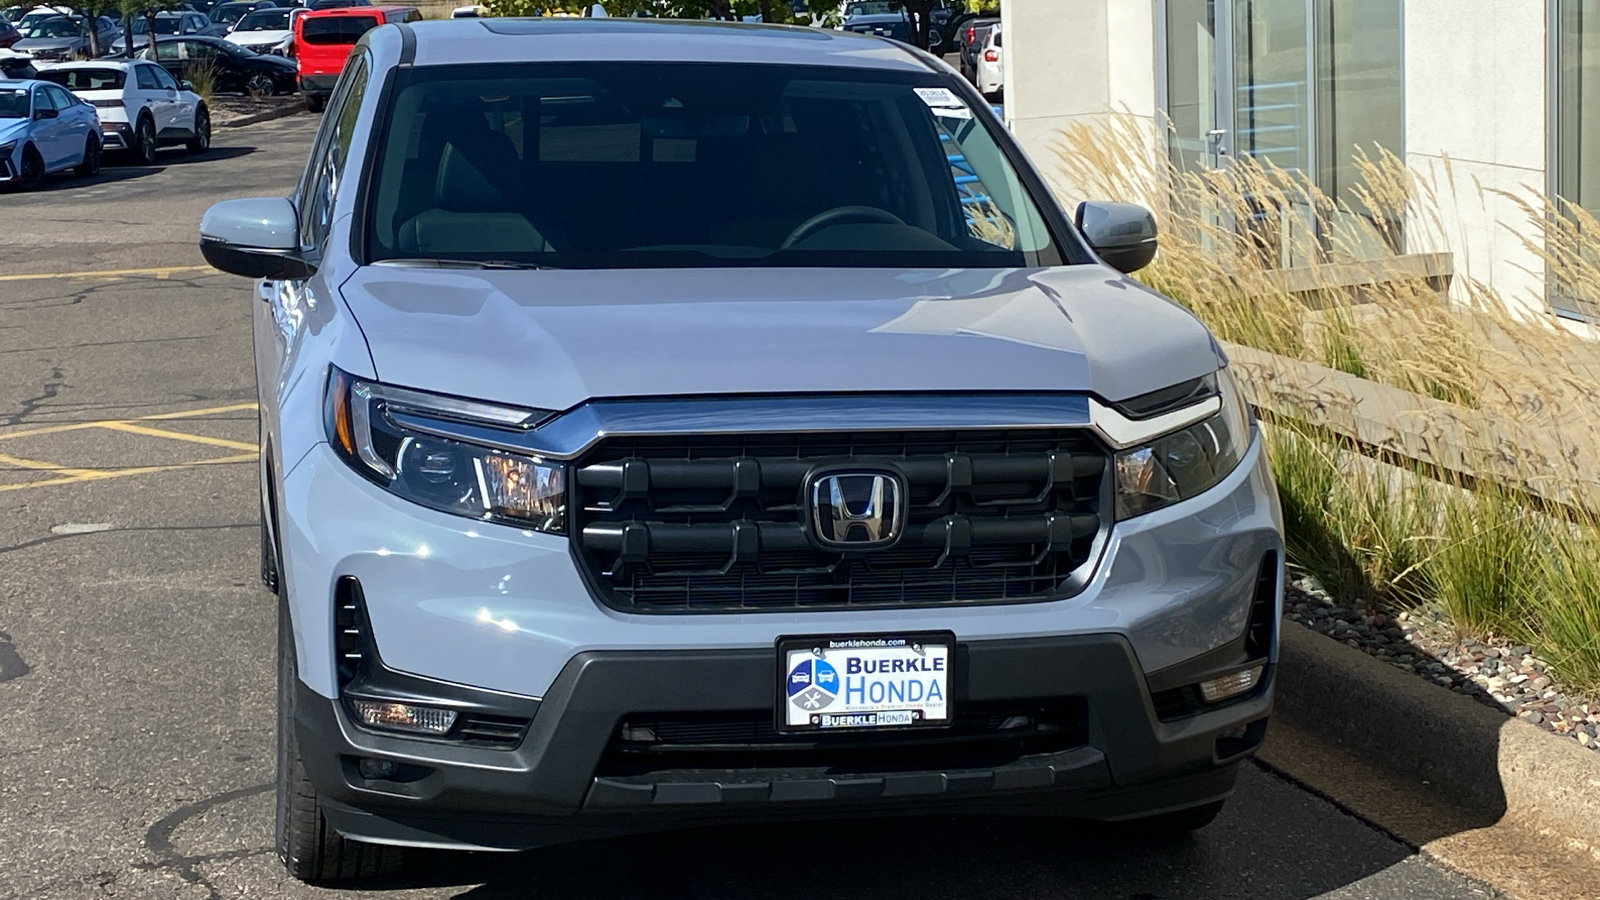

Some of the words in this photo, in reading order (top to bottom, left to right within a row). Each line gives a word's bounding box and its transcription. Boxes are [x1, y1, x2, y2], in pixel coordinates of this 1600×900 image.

[829, 639, 906, 648] buerklehonda.com
[846, 657, 944, 675] BUERKLE
[845, 676, 943, 705] HONDA
[822, 714, 876, 726] BUERKLE
[878, 713, 910, 724] HONDA
